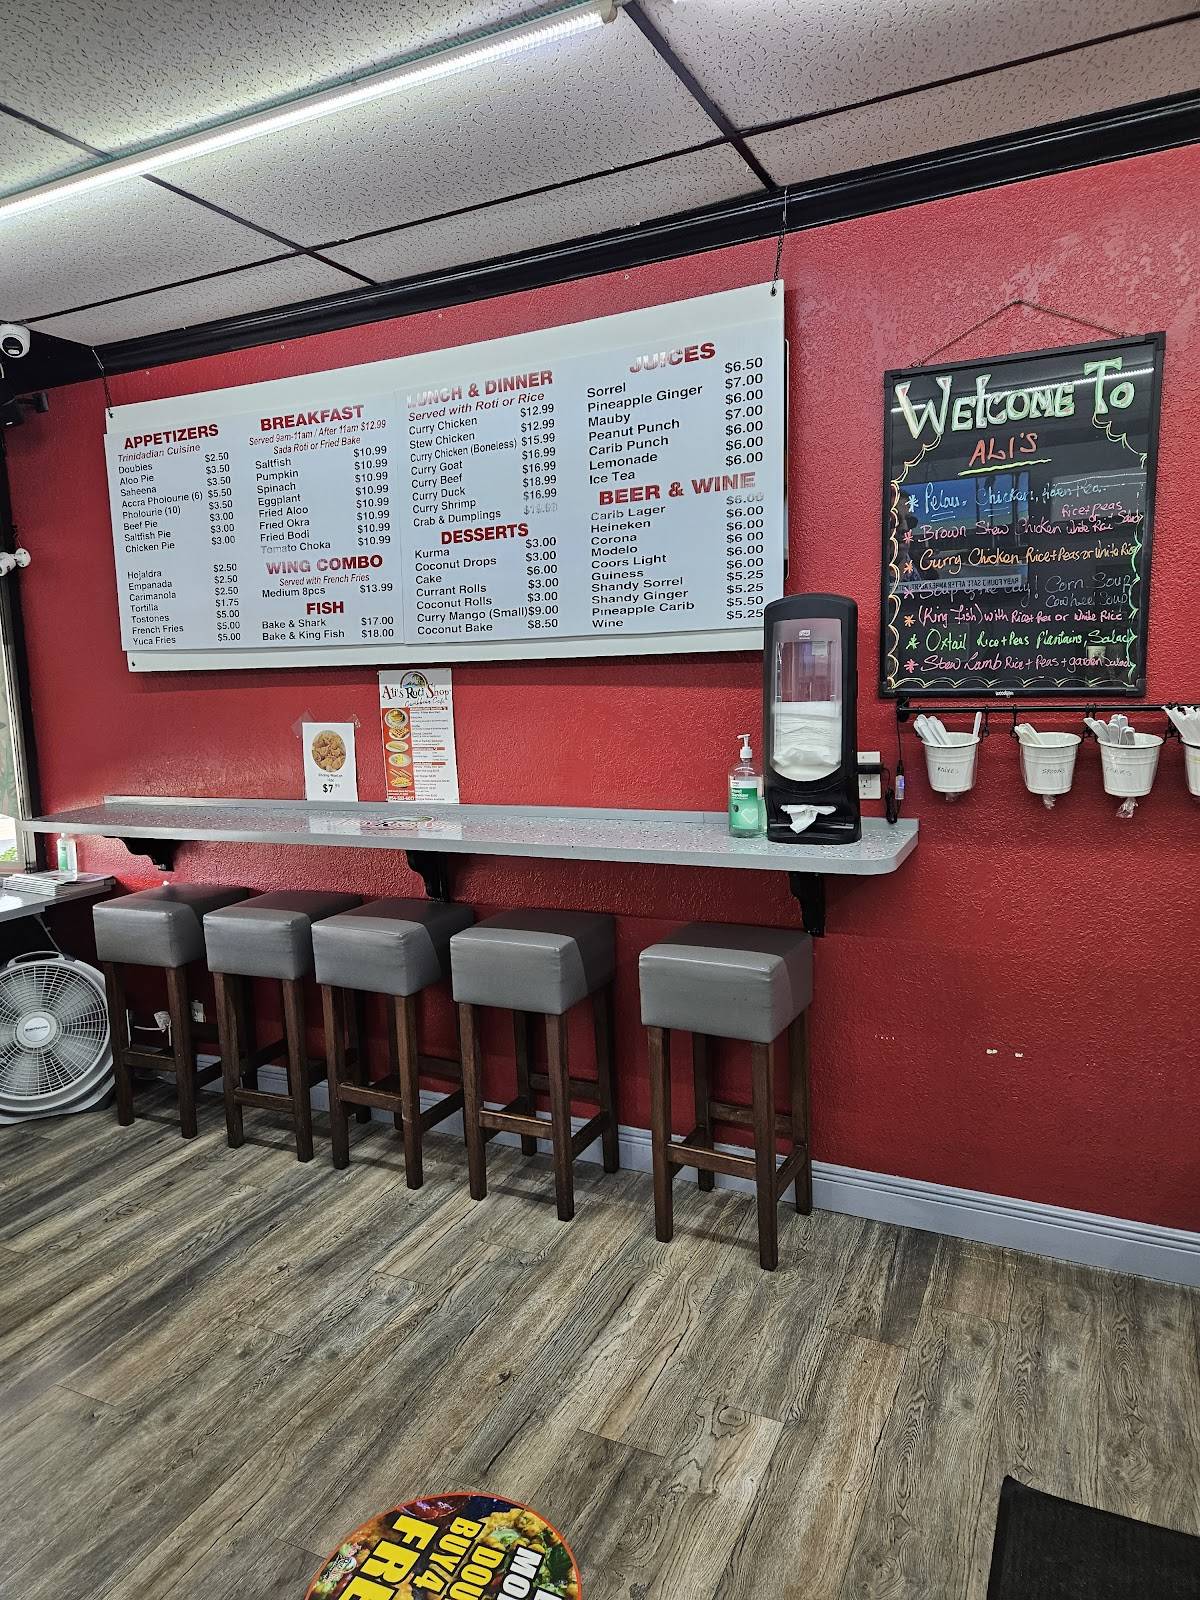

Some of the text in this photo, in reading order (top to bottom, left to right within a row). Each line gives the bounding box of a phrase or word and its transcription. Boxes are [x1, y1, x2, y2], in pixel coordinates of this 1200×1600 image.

[629, 342, 716, 374] JUICES
[485, 369, 553, 395] DINNER
[587, 357, 763, 398] Sorrel $6.50
[588, 373, 763, 413] Pineapple Ginger $7.00
[408, 392, 545, 422] Served with Roti or Rice
[589, 389, 763, 428] Mauby $6.00
[260, 404, 364, 431] BREAKFAST
[409, 404, 554, 436] Curry Chicken $12.99
[589, 404, 763, 442] Peanut Punch $7.00
[124, 423, 219, 449] APPETIZERS
[249, 436, 274, 446] Served
[410, 432, 475, 449] Stew Chicken
[589, 420, 763, 456] Carib Punch $6.00
[434, 433, 555, 458] Chicken $15.99
[205, 452, 229, 462] $2.50
[256, 446, 387, 469] Saltfish $10.99
[439, 447, 555, 472] Goat $16.99
[589, 452, 657, 471] Lemonade
[256, 469, 298, 482] Pumpkin
[440, 474, 462, 484] Beef
[589, 471, 635, 485] Ice Tea
[257, 482, 296, 495] Spinach
[441, 475, 556, 498] Duck $18.99
[599, 472, 756, 506] BEER & WINE
[192, 491, 203, 501] (6)
[258, 494, 301, 507] Eggplant
[165, 506, 181, 515] (10)
[259, 506, 308, 518] Fried Aloo
[441, 499, 476, 513] Shrimp
[591, 505, 666, 521] Carib Lager
[260, 519, 309, 530] Fried Okra
[413, 508, 501, 527] Crab Dumplings
[441, 522, 528, 545] DESSERTS
[591, 520, 651, 533] Heineken
[918, 525, 967, 542] Brown
[975, 521, 1009, 535] Stew
[125, 530, 171, 542] Saltfish Pie
[260, 530, 309, 542] Fried Bodi
[591, 534, 637, 546] Corona
[126, 541, 175, 553] Chicken Pie
[300, 541, 330, 551] Choka
[415, 548, 450, 559] Kurma
[592, 545, 638, 557] Modelo
[592, 555, 666, 569] Coors Light
[969, 548, 1019, 565] Chicken
[266, 554, 383, 575] WING COMBO
[415, 558, 496, 572] Coconut Drops
[279, 574, 349, 586] Served French
[416, 565, 557, 585] Cake $6.00
[592, 570, 644, 581] Guiness
[592, 570, 764, 594] Shandy Sorrel $5.25
[129, 580, 172, 591] Empanada
[262, 583, 392, 598] Medium 8pcs $13.99
[417, 583, 487, 597] Currant Rolls
[417, 596, 492, 610] Coconut Rolls
[592, 589, 688, 606] Shandy Ginger
[130, 598, 239, 613] Tortilla $1.75
[306, 601, 344, 615] FISH
[593, 596, 763, 618] Pineapple Carib $5.50
[132, 614, 169, 624] Tostones
[262, 617, 393, 629] Bake Shark $17.00
[418, 609, 486, 624] Curry Mango
[593, 618, 623, 628] Wine
[133, 624, 183, 634] French Fries
[418, 619, 558, 635] Coconut Bake $8.50
[133, 633, 241, 645] Yuca Fries $5.00
[262, 629, 394, 641] Bake King Fish $18.00
[926, 628, 967, 651] Oxtail
[920, 655, 961, 671] Stew
[964, 652, 1002, 670] Lamb
[382, 685, 403, 700] Ali's
[413, 1517, 482, 1592] BUY 4
